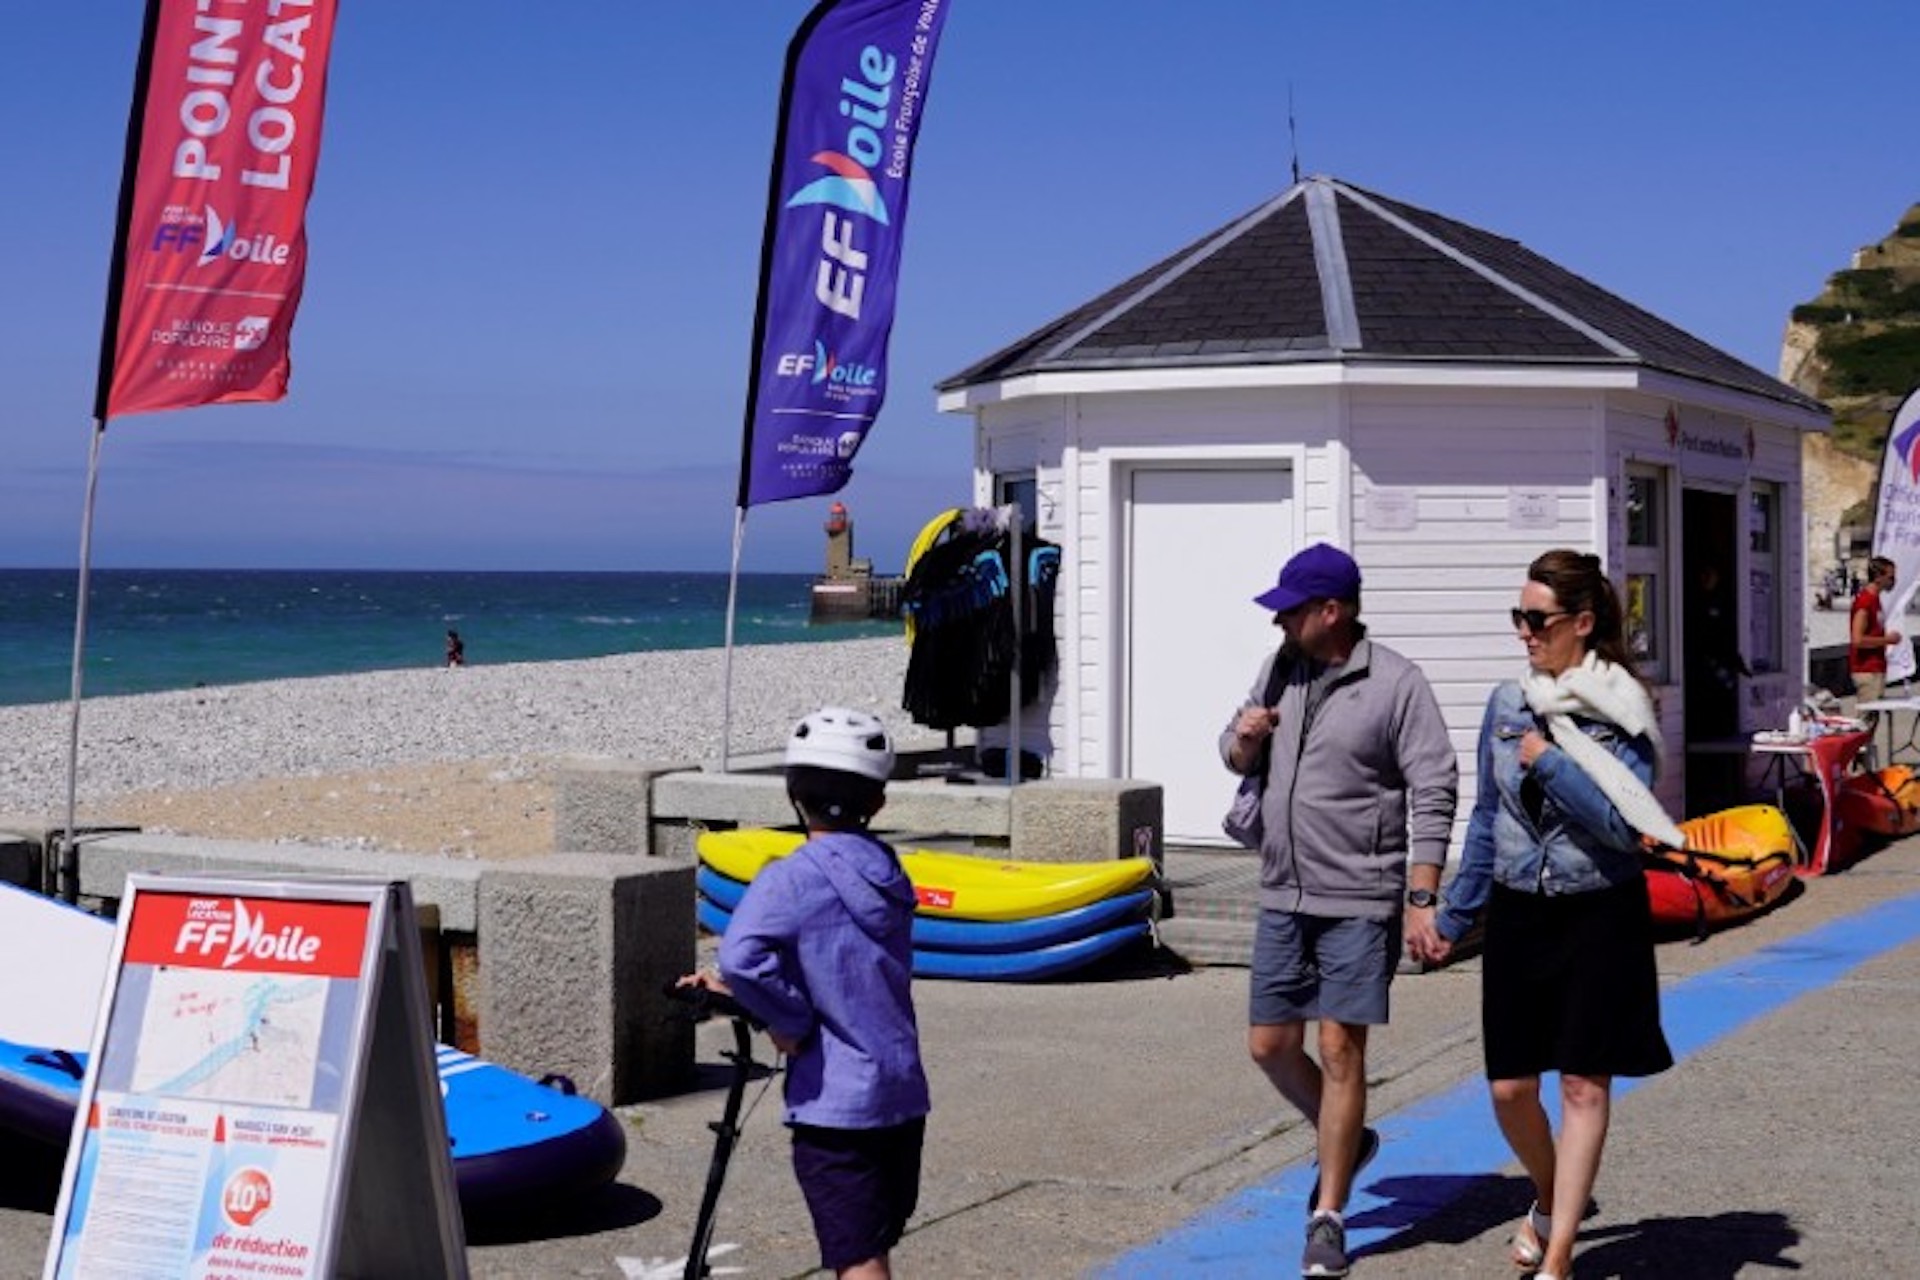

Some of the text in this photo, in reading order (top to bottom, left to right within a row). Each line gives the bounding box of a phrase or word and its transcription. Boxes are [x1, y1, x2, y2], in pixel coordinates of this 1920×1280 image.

[911, 35, 927, 55] de
[212, 1232, 308, 1259] de réduction
